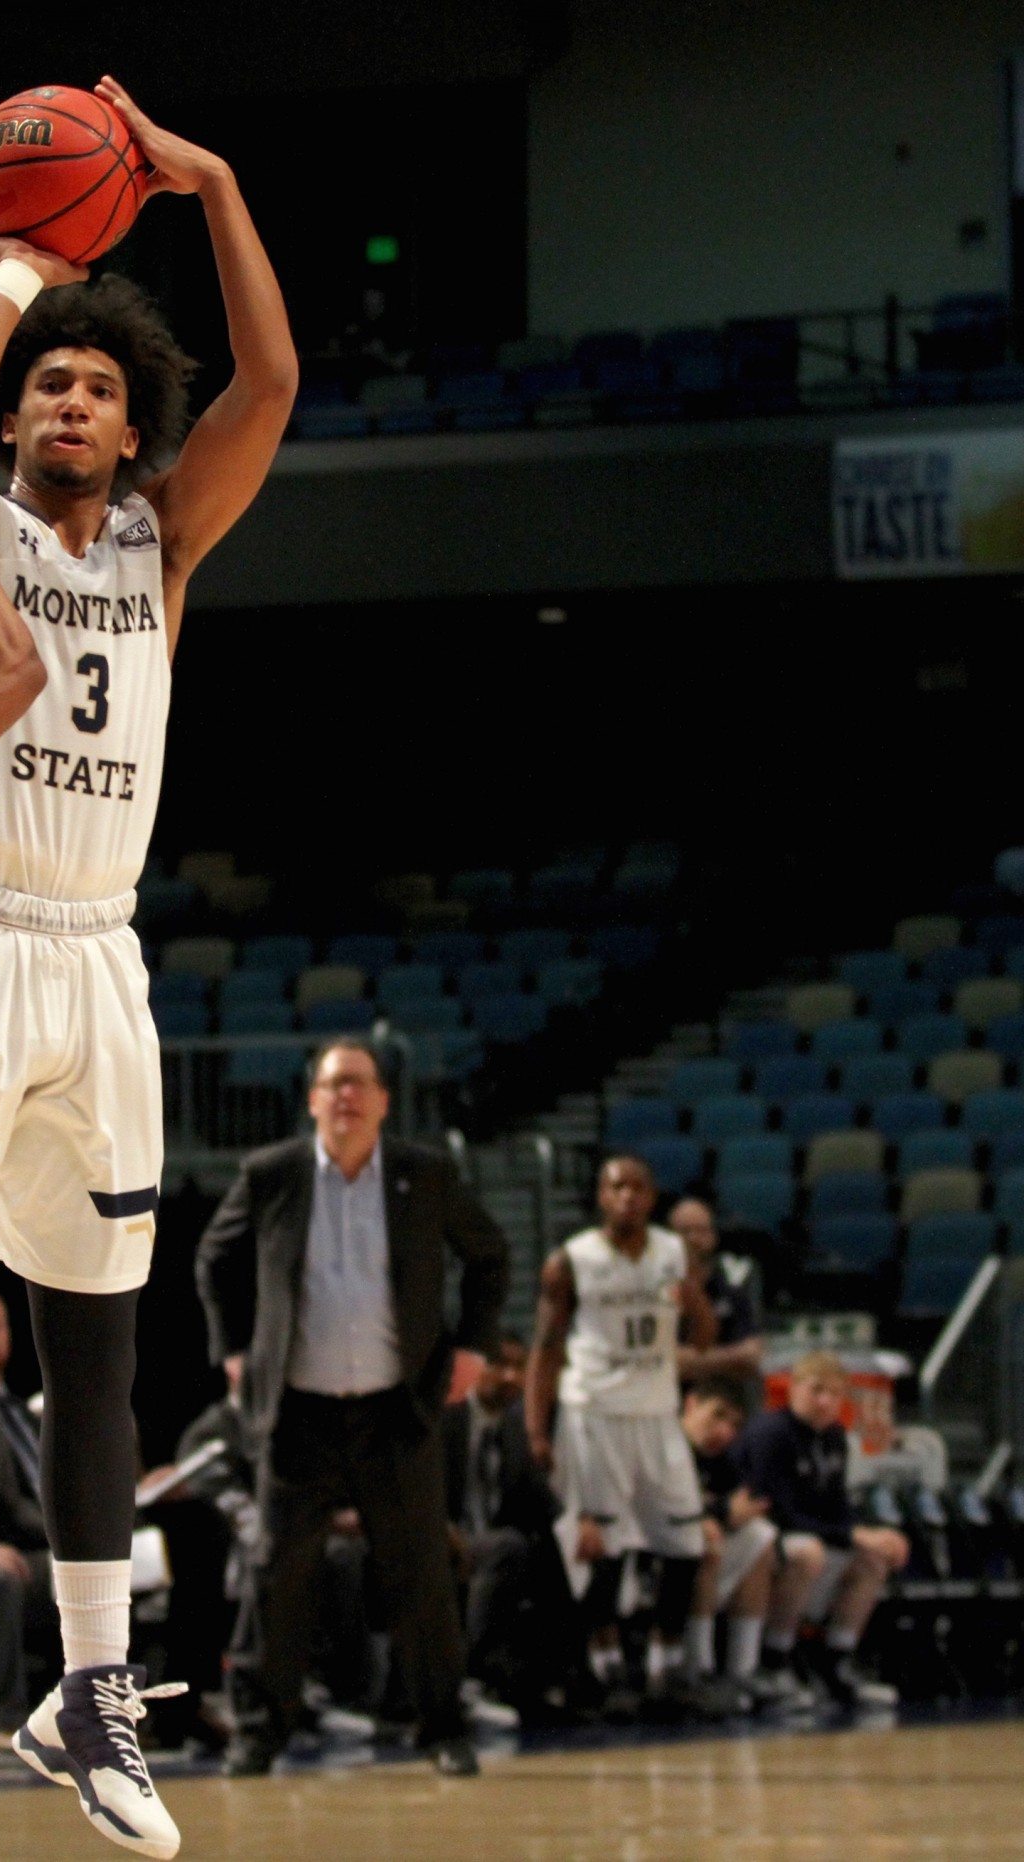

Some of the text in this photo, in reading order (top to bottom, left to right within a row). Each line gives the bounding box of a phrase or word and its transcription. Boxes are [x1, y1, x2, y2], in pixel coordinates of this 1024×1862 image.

[837, 494, 952, 560] TASTE
[13, 574, 158, 636] MONTANA
[72, 653, 109, 734] 3
[11, 744, 136, 801] STATE
[625, 1313, 657, 1349] 10
